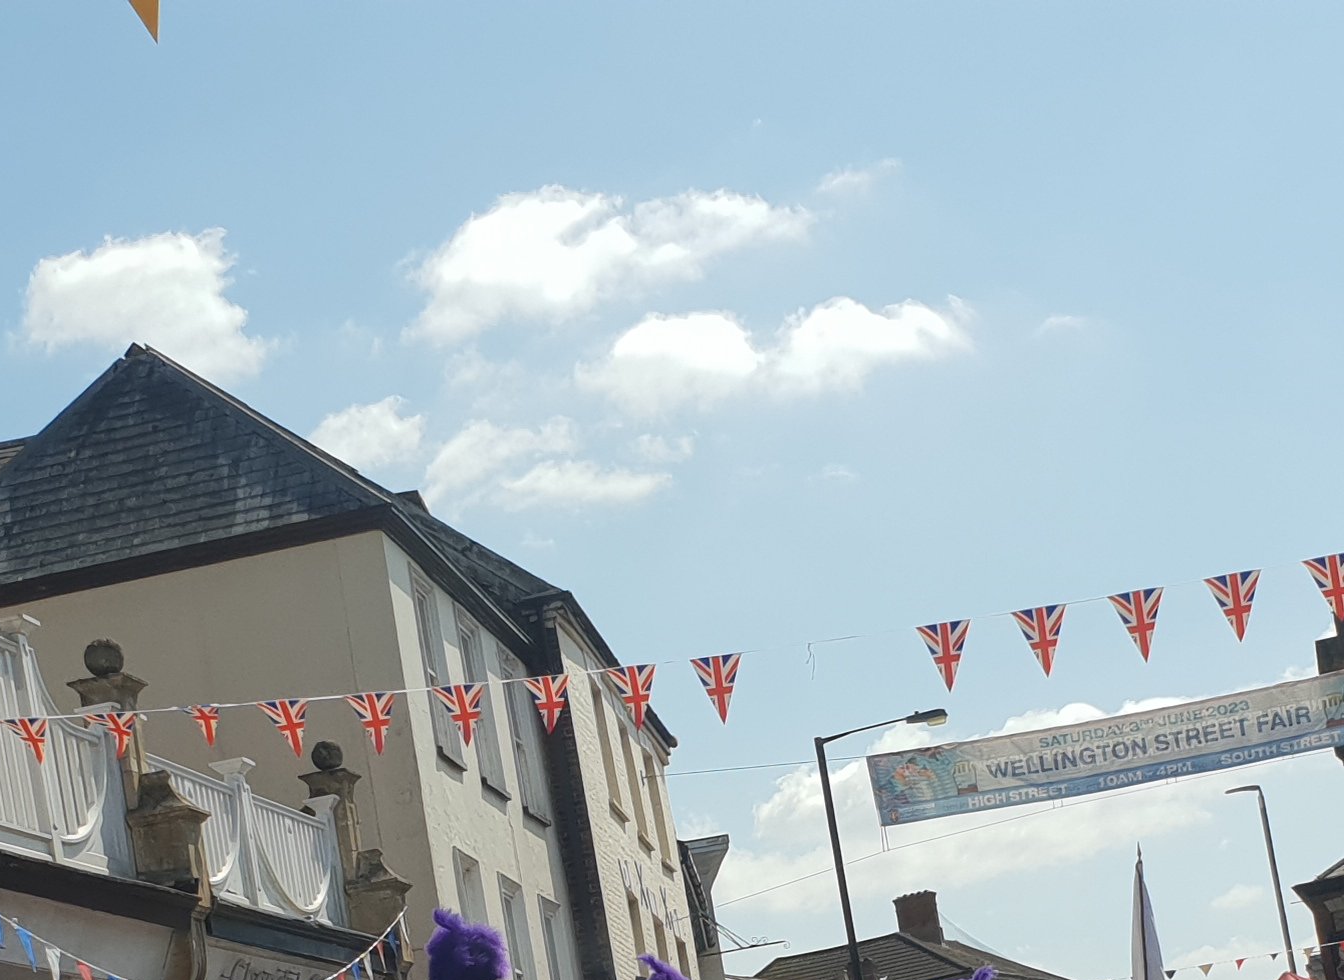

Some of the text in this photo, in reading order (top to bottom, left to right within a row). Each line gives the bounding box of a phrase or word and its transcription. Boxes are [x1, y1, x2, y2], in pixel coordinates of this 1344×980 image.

[985, 705, 1312, 779] WELLINGTON STREET FAIR
[1038, 722, 1125, 749] SATURDAY
[1157, 708, 1203, 728] JUNE
[1206, 699, 1250, 718] 2023
[968, 790, 1007, 809] HIGH
[1009, 783, 1069, 801] STREET
[1098, 770, 1144, 788] 10AM
[1156, 761, 1193, 777] 4PM
[1220, 744, 1277, 765] SOUTH
[1278, 731, 1341, 752] STREET
